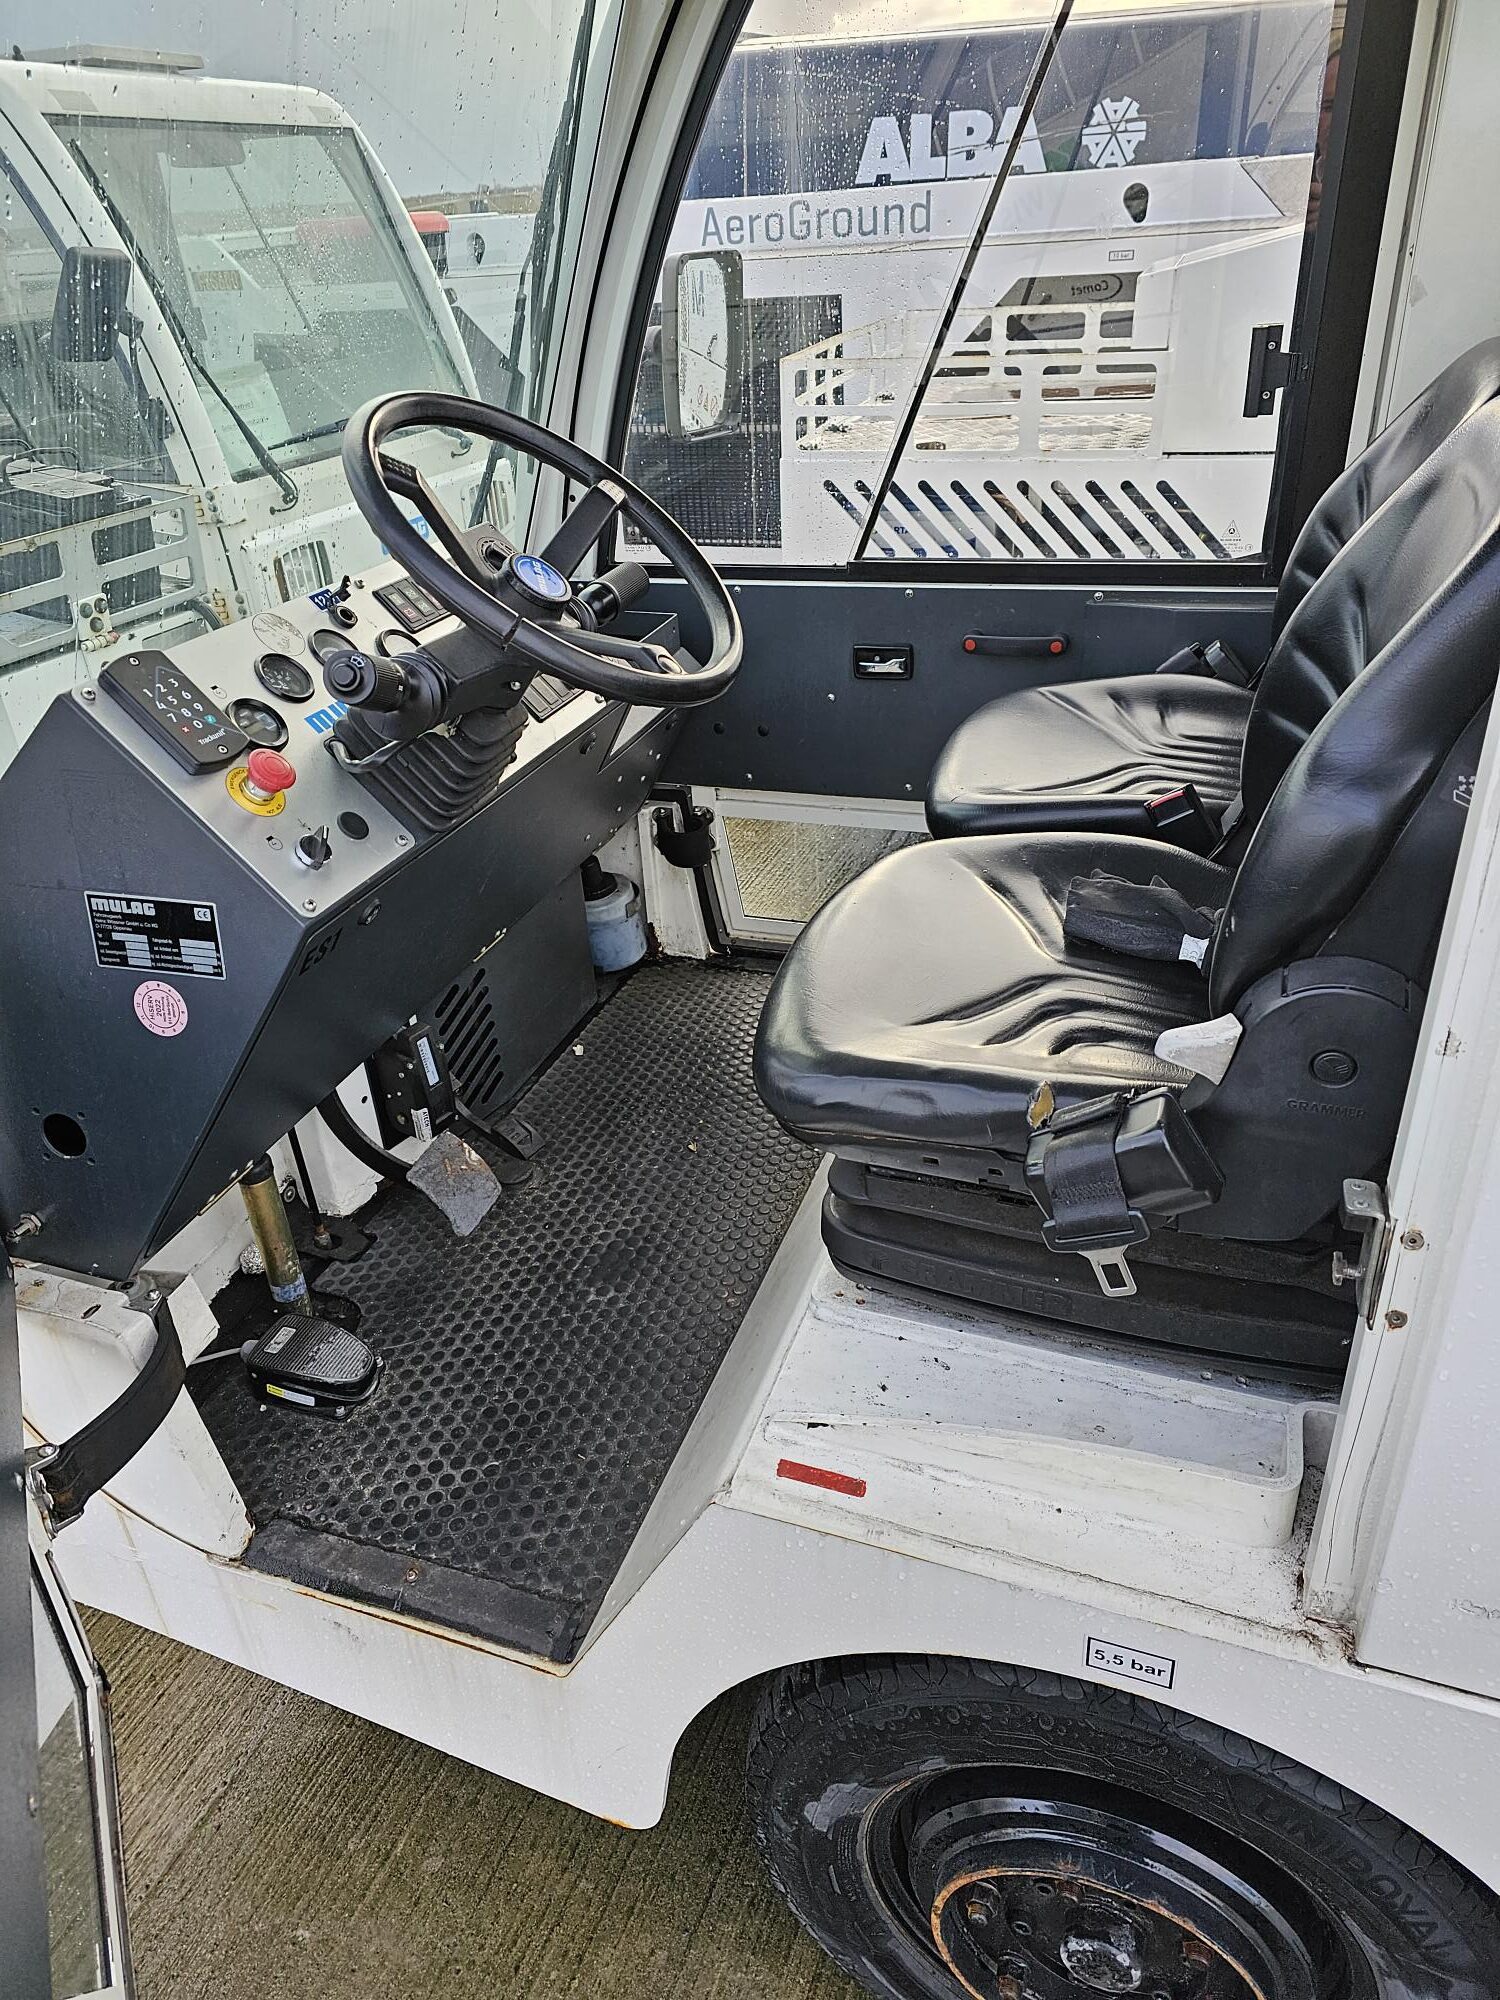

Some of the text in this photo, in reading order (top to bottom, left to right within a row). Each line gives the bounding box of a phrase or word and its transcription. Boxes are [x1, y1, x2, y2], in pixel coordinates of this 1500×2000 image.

[854, 106, 1047, 185] ALBA
[701, 190, 932, 247] AeroGround
[143, 678, 179, 698] 1 2 3
[156, 690, 192, 709] 4 5 6
[166, 702, 203, 723] 7 8 9
[193, 720, 203, 729] 0
[198, 728, 226, 745] Trackunit
[91, 897, 156, 916] MULAG
[1287, 1098, 1367, 1119] GRAMMER
[1094, 1649, 1167, 1677] 5,5 bar
